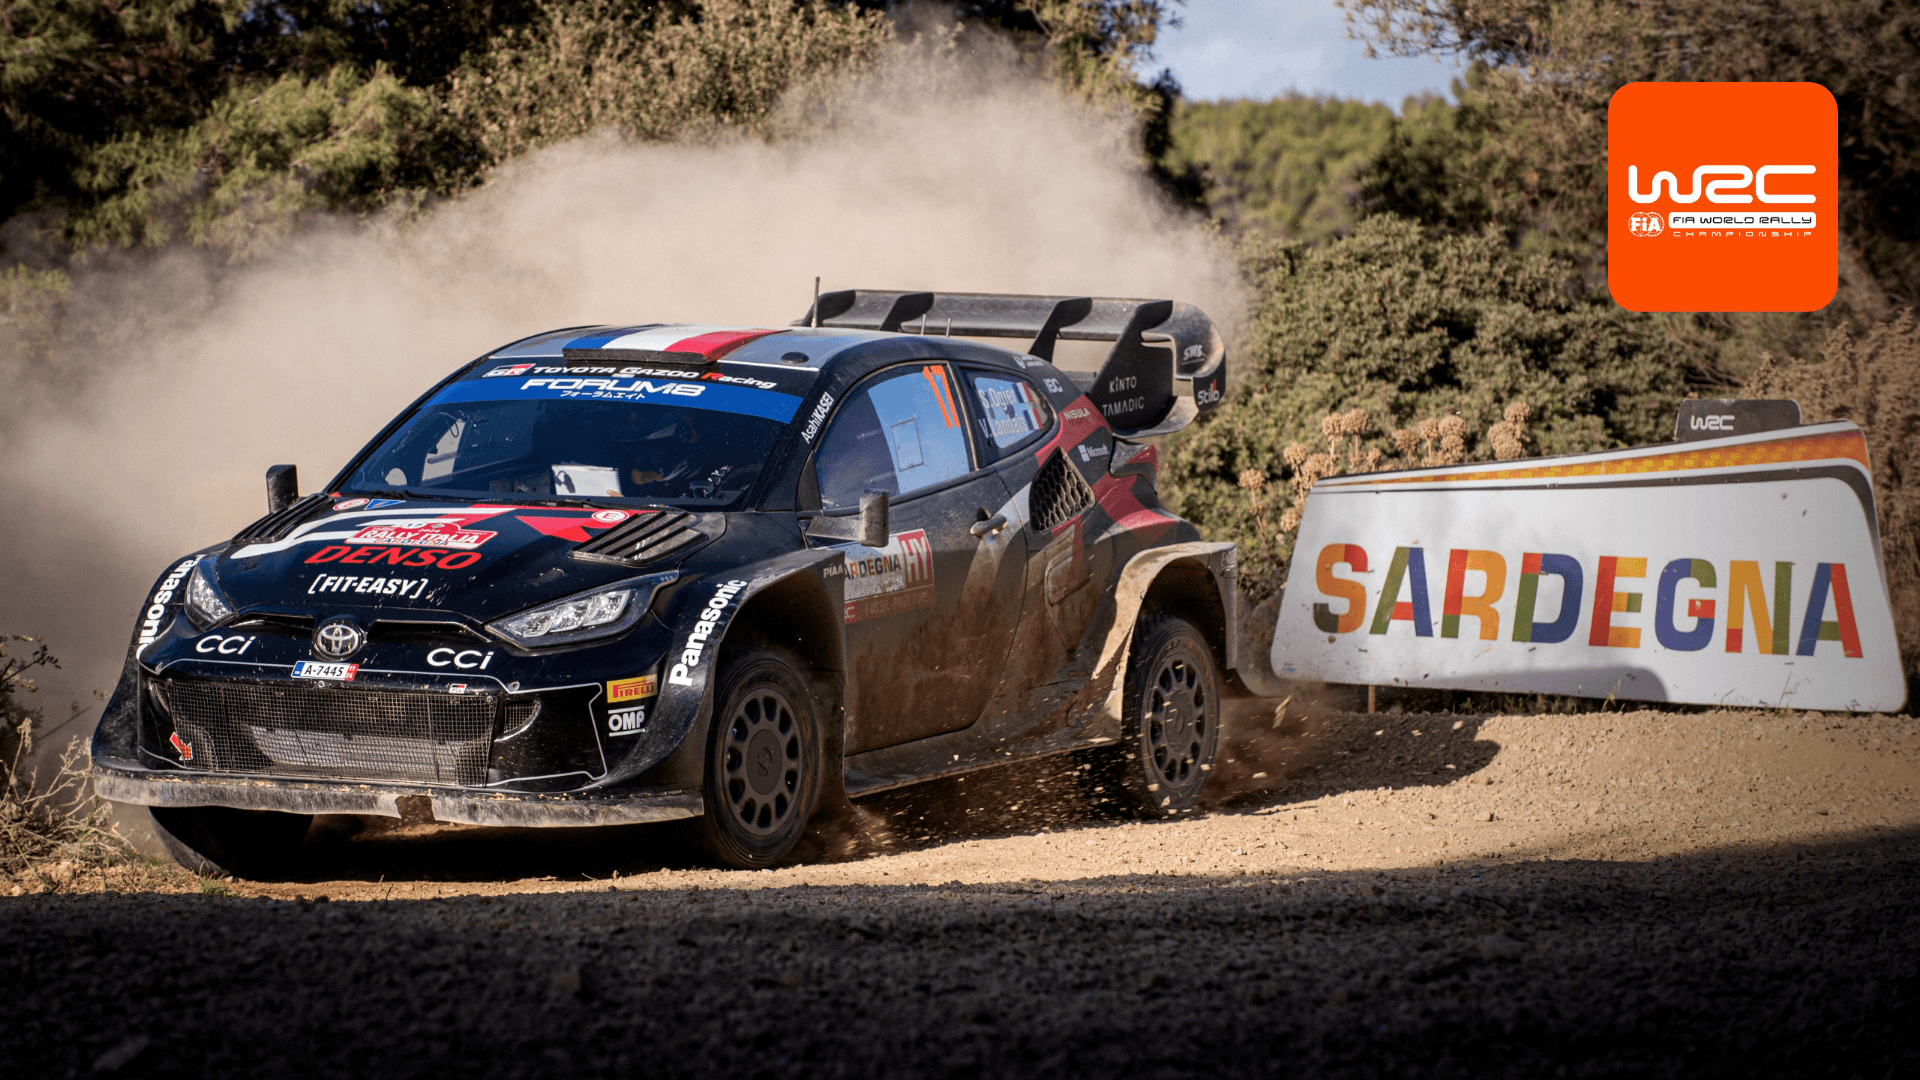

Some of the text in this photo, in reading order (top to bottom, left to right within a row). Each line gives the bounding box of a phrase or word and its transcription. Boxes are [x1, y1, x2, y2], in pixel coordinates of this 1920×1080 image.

[520, 378, 706, 398] FORUM8
[532, 366, 617, 375] TOYOTA
[701, 371, 778, 389] Racing
[560, 390, 646, 400] フォーラムエイト
[922, 365, 961, 428] 17
[801, 391, 835, 445] AsahiKASEI
[1063, 407, 1091, 420] NISULA
[1102, 396, 1145, 418] TAMADIC
[1689, 414, 1736, 431] WRC
[359, 530, 421, 540] RALLY
[418, 533, 480, 544] ITALIA
[303, 546, 482, 570] DENSO
[844, 554, 902, 581] ARDEGNA
[1312, 543, 1865, 660] SARDEGNA
[668, 579, 748, 687] Panasonic
[303, 664, 345, 677] A-7445
[612, 677, 655, 698] PIRELLI
[608, 710, 645, 732] OMP
